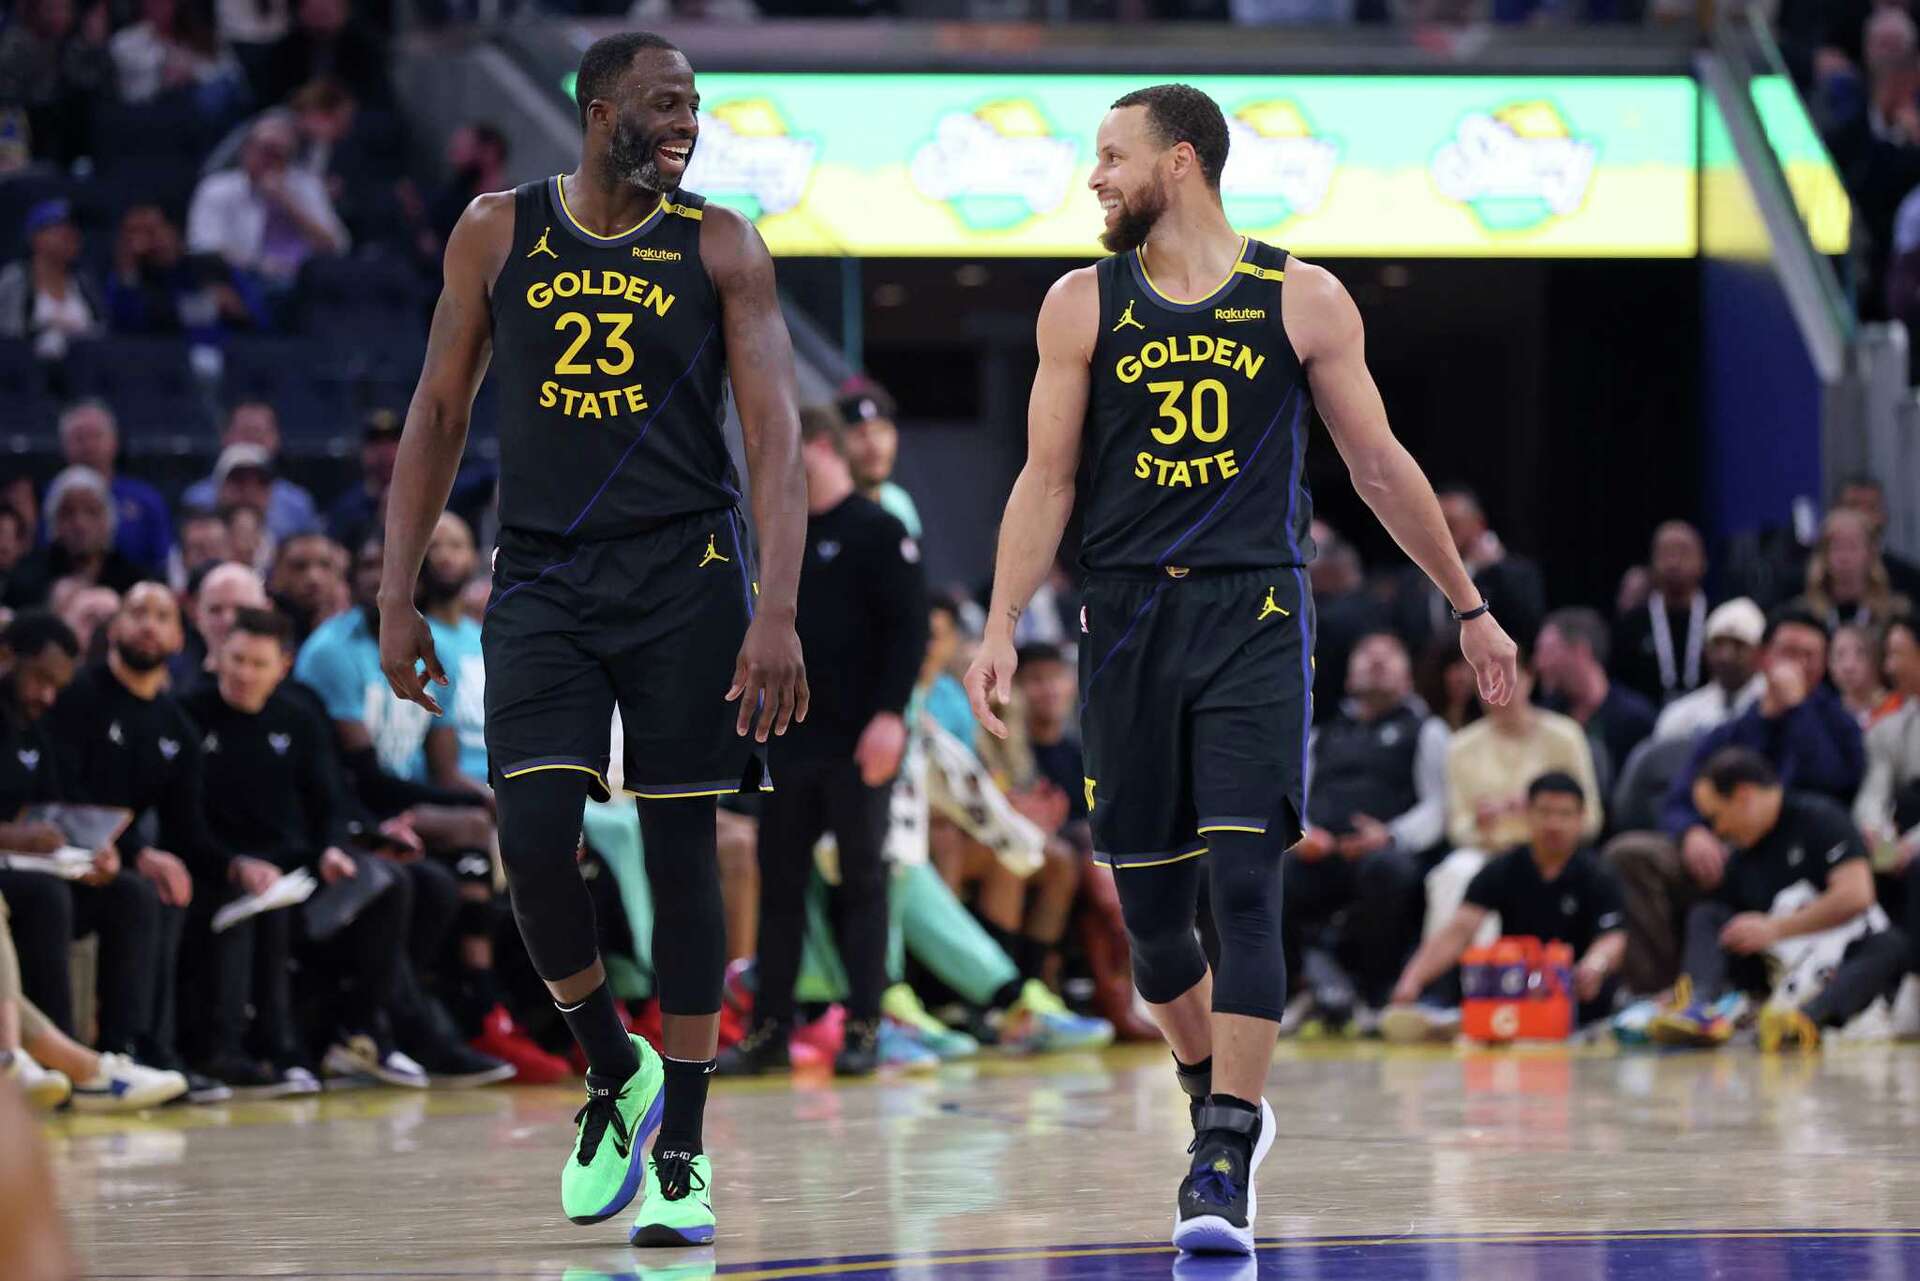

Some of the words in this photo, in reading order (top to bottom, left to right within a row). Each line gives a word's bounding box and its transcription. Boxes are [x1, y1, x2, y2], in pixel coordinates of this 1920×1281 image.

[632, 247, 681, 261] Rakuten
[527, 269, 675, 317] GOLDEN
[1215, 308, 1265, 321] Rakuten
[554, 311, 635, 376] 23
[1116, 334, 1265, 384] GOLDEN
[539, 380, 648, 419] STATE
[1146, 378, 1229, 445] 30
[1134, 449, 1240, 488] STATE
